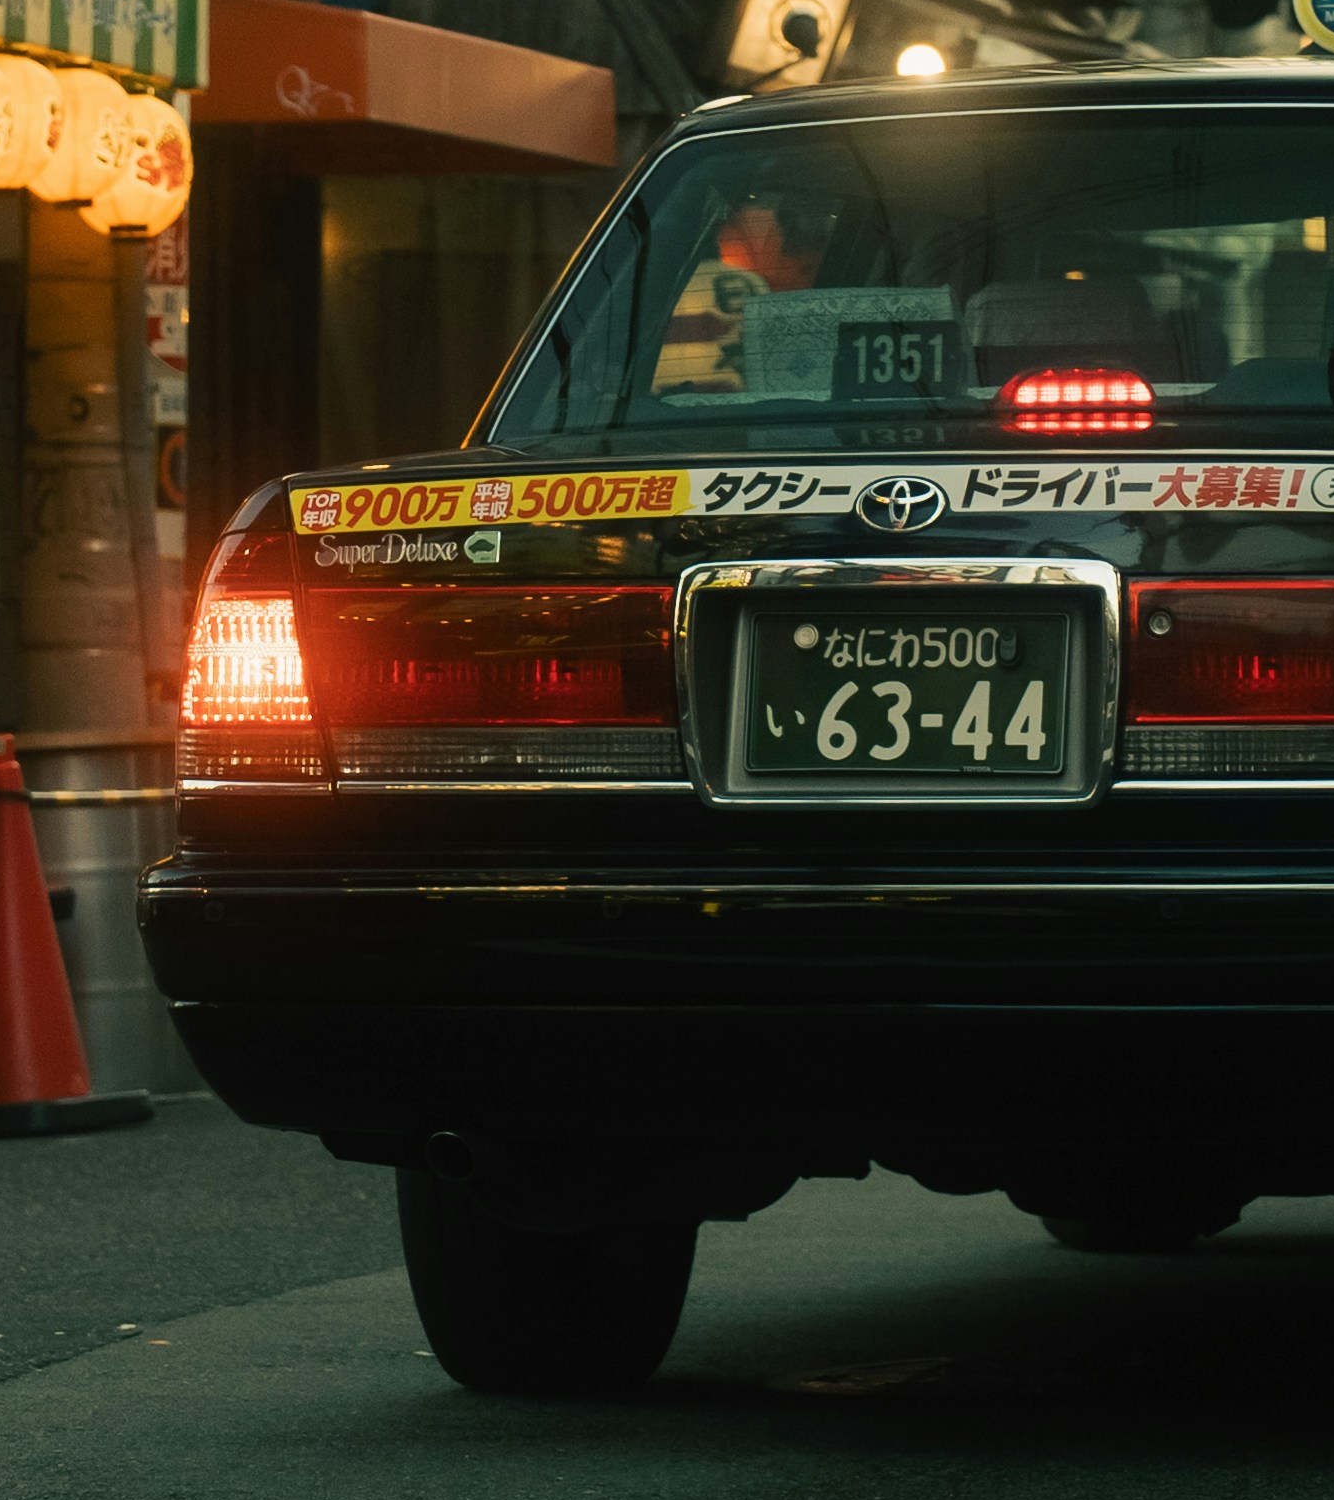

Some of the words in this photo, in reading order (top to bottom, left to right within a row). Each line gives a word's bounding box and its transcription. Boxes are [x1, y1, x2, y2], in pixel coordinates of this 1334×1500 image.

[851, 333, 945, 385] 1351
[306, 493, 341, 509] TOP
[345, 485, 465, 528] 900万
[471, 501, 509, 521] 年収
[474, 481, 512, 501] 平均
[516, 474, 678, 520] 500万超
[702, 471, 852, 512] タクシー
[301, 509, 337, 528] 年収
[314, 535, 381, 574] Super
[378, 532, 459, 565] Deluxe
[766, 703, 806, 738] い
[817, 680, 1047, 762] 63-44
